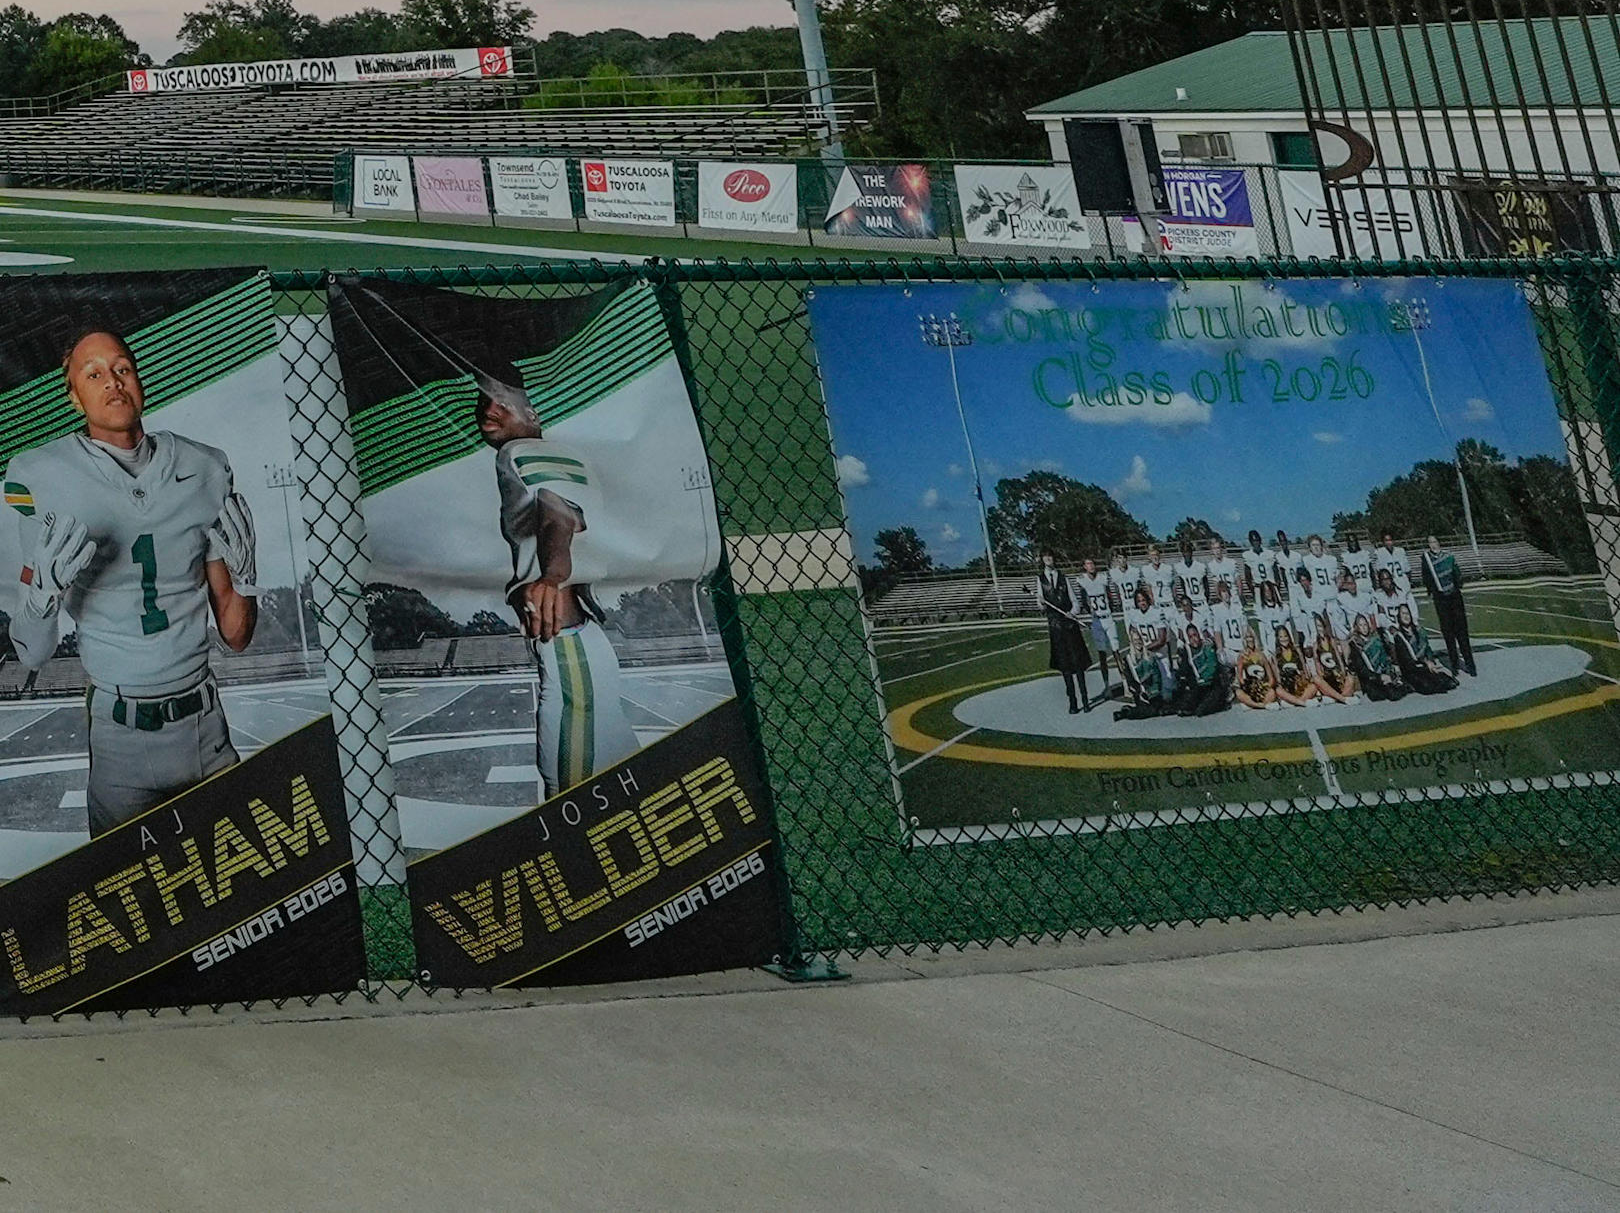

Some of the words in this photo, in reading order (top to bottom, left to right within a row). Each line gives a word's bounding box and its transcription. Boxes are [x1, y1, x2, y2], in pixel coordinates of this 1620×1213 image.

[372, 168, 402, 182] LOCAL
[496, 162, 535, 173] Townsend
[608, 166, 670, 178] TUSCALOOSA
[373, 183, 399, 197] BANK
[609, 180, 647, 192] TOYOTA
[862, 174, 886, 188] THE
[855, 195, 907, 208] IREWORK
[592, 209, 668, 222] TuscaloosaToyota.com
[701, 206, 724, 220] First
[725, 210, 738, 221] on
[740, 209, 758, 225] Any
[865, 215, 893, 228] MAN
[1167, 227, 1200, 236] PICKENS
[1202, 229, 1237, 239] COUNTY
[1168, 235, 1204, 245] DISTRICT
[1206, 237, 1232, 247] JUDGE
[1032, 350, 1176, 410] Class
[1191, 349, 1247, 404] of
[1263, 349, 1375, 404] 2026
[1258, 563, 1268, 579] 9
[1315, 568, 1331, 586] 51
[1352, 564, 1368, 580] 22
[1386, 561, 1403, 578] 72
[130, 532, 168, 636] 1
[1120, 582, 1134, 600] 12
[1155, 580, 1164, 598] 7
[1185, 577, 1200, 596] 16
[1088, 594, 1108, 612] 33
[1137, 624, 1156, 643] 50
[1225, 619, 1241, 639] 13
[1097, 770, 1159, 794] From
[1162, 757, 1246, 789] Candid
[1364, 737, 1511, 779] Photography
[537, 767, 640, 842] JOSH
[424, 755, 757, 965] WILDER
[0, 773, 332, 995] LATHAM
[622, 885, 709, 949] SENIOR
[706, 851, 766, 900] 2026
[191, 907, 286, 973] SENIOR
[282, 871, 348, 921] 2026
